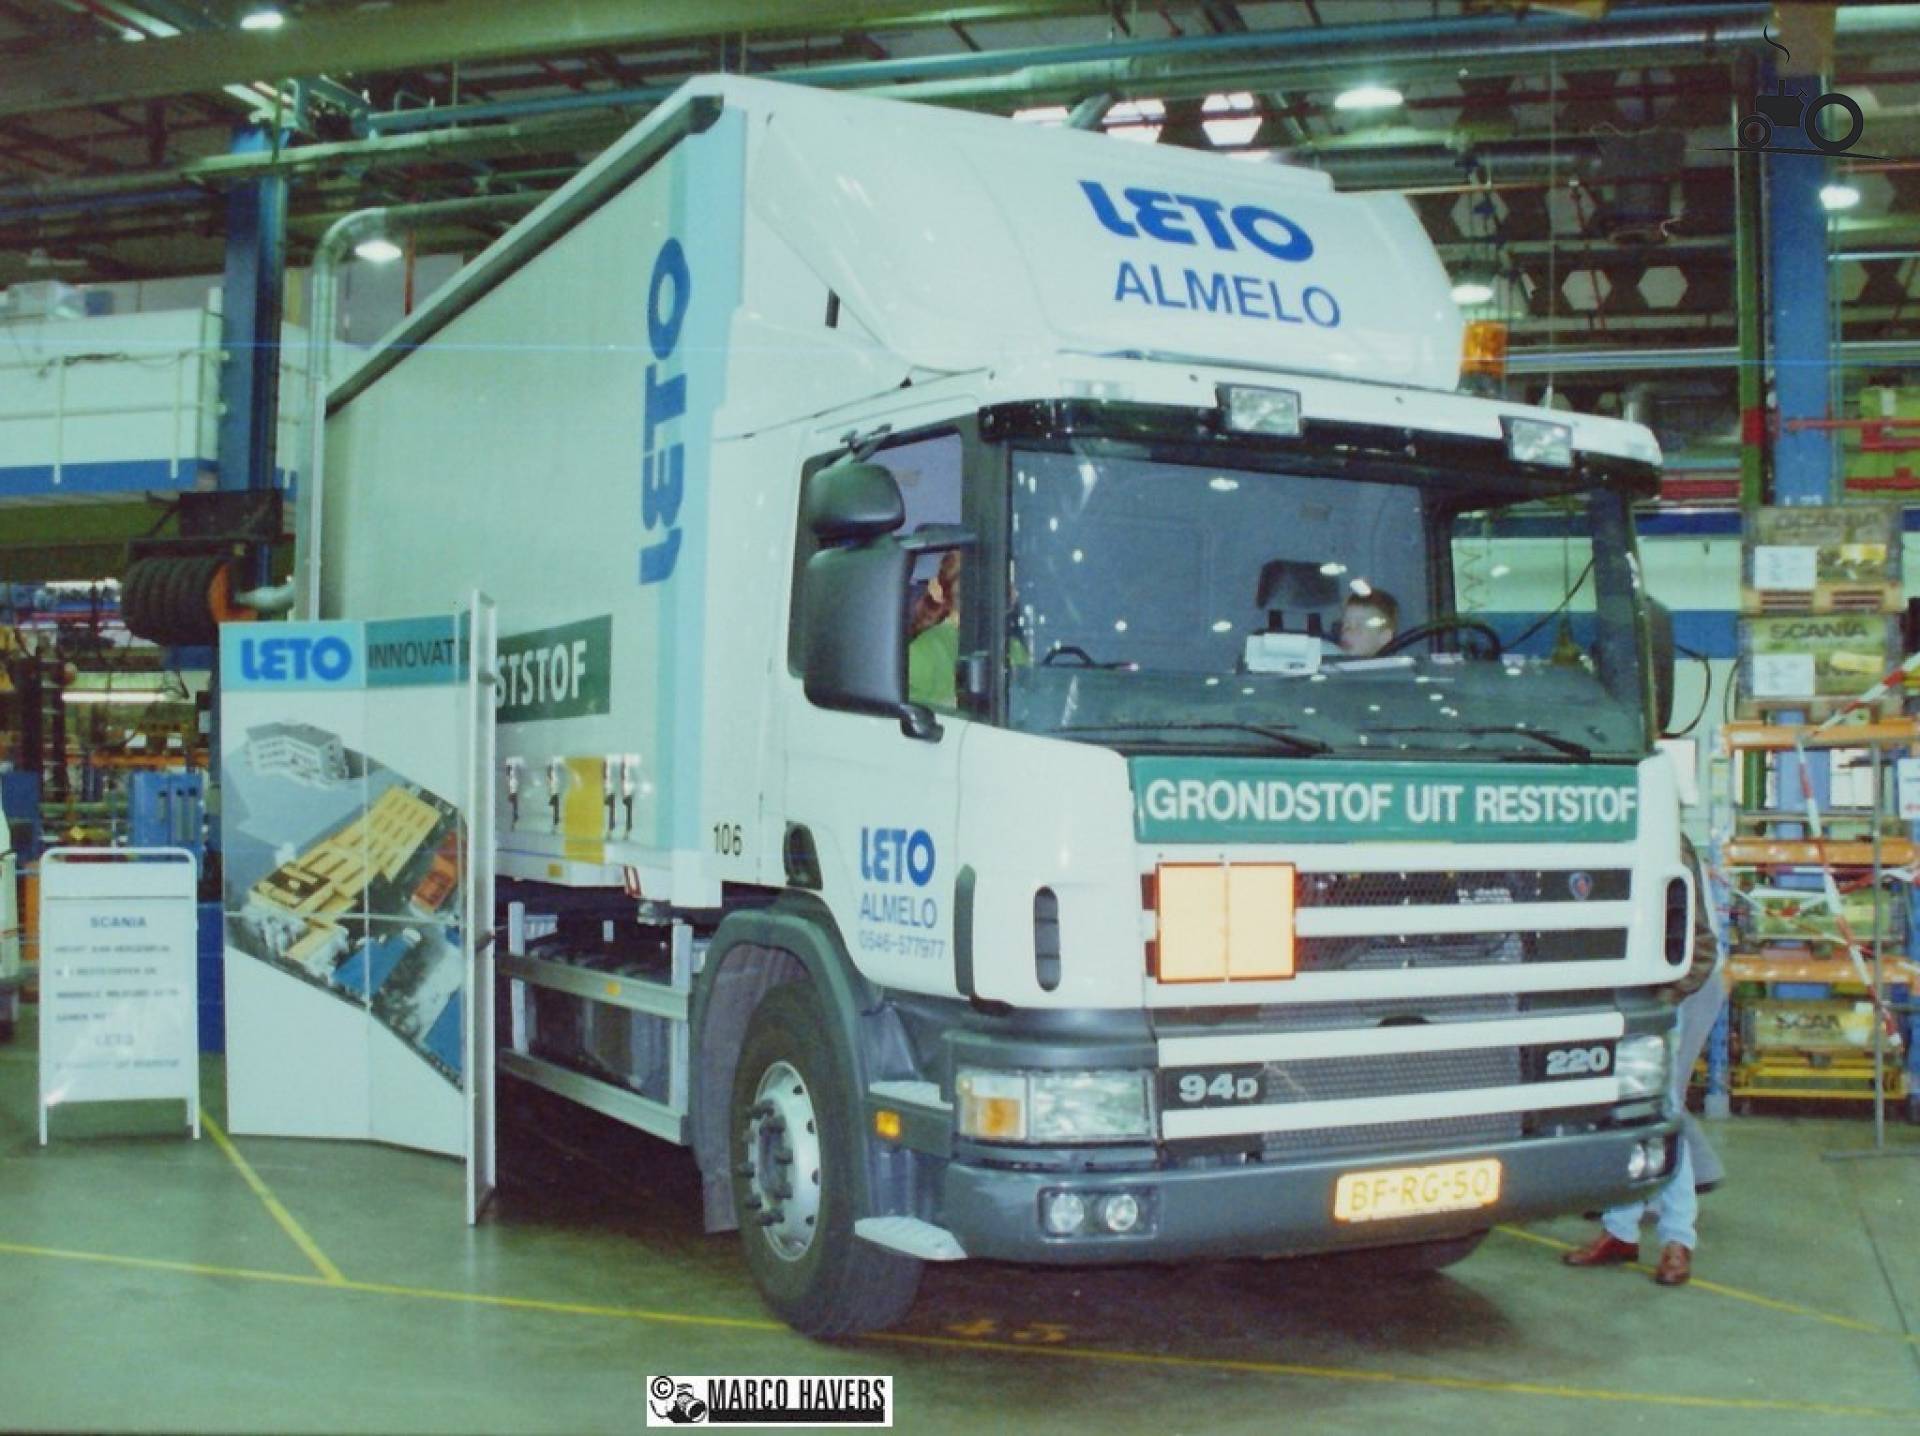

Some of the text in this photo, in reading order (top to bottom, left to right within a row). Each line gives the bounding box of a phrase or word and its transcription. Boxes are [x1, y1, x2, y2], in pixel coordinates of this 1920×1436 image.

[1078, 179, 1314, 262] LETO
[1115, 261, 1340, 328] ALMELO
[639, 237, 691, 586] LETO
[240, 636, 352, 681] LETO
[1146, 778, 1637, 824] GRONDSTOF UIT RESTSTOF
[713, 824, 743, 857] 106
[860, 826, 936, 888] LETO
[89, 916, 147, 929] SCANIA
[859, 892, 937, 929] ALMELO
[1545, 1046, 1610, 1077] 220
[1178, 1073, 1259, 1102] 94D
[1350, 1166, 1491, 1212] BF-RG-50
